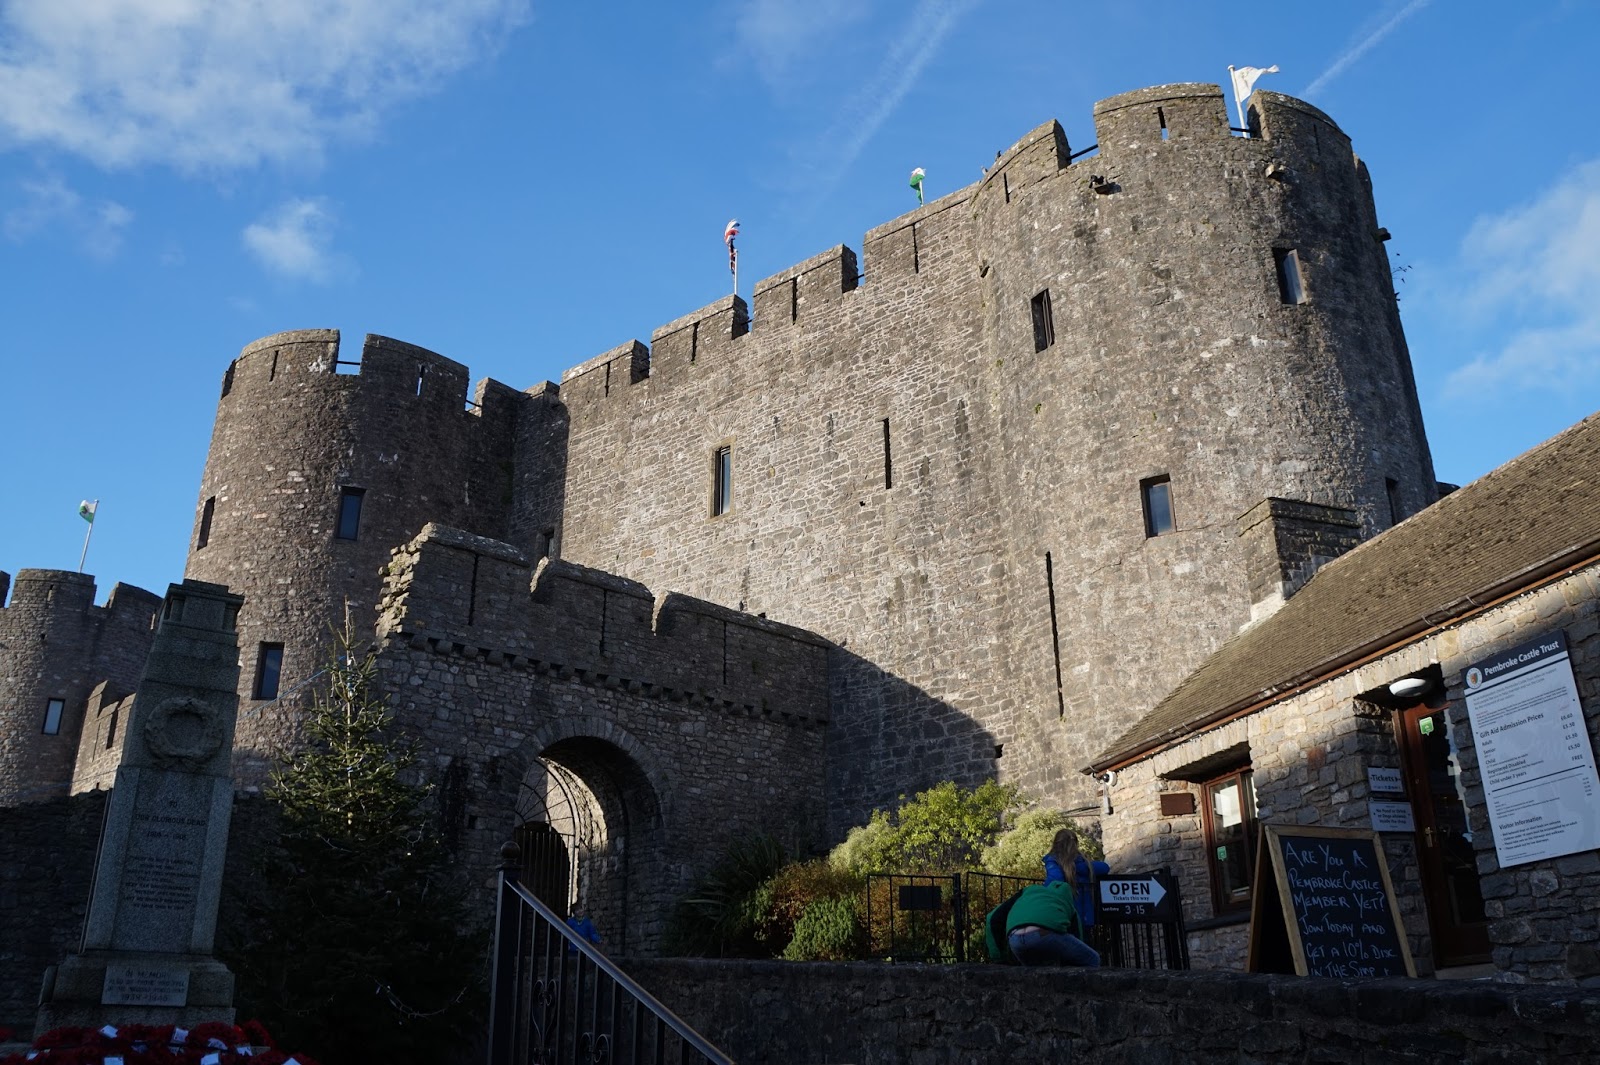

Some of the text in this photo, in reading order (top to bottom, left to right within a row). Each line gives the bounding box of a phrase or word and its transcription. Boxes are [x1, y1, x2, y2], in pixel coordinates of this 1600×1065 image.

[1484, 640, 1560, 676] Pembroke Castle Trust
[1480, 713, 1544, 738] Gift Aid Admission Prices
[152, 816, 185, 824] GLORIOUS
[187, 818, 206, 826] DEAD
[1499, 816, 1542, 830] Visitor Information
[1352, 850, 1368, 868] A
[1109, 883, 1150, 895] OPEN
[1288, 868, 1379, 892] PEMBROKE CASTLE
[1294, 891, 1384, 918] MEMBER YET?
[1322, 913, 1353, 937] TODAY
[1306, 943, 1325, 965] GET
[1331, 948, 1339, 957] A
[1343, 939, 1369, 959] 10%
[1325, 961, 1349, 977] THE
